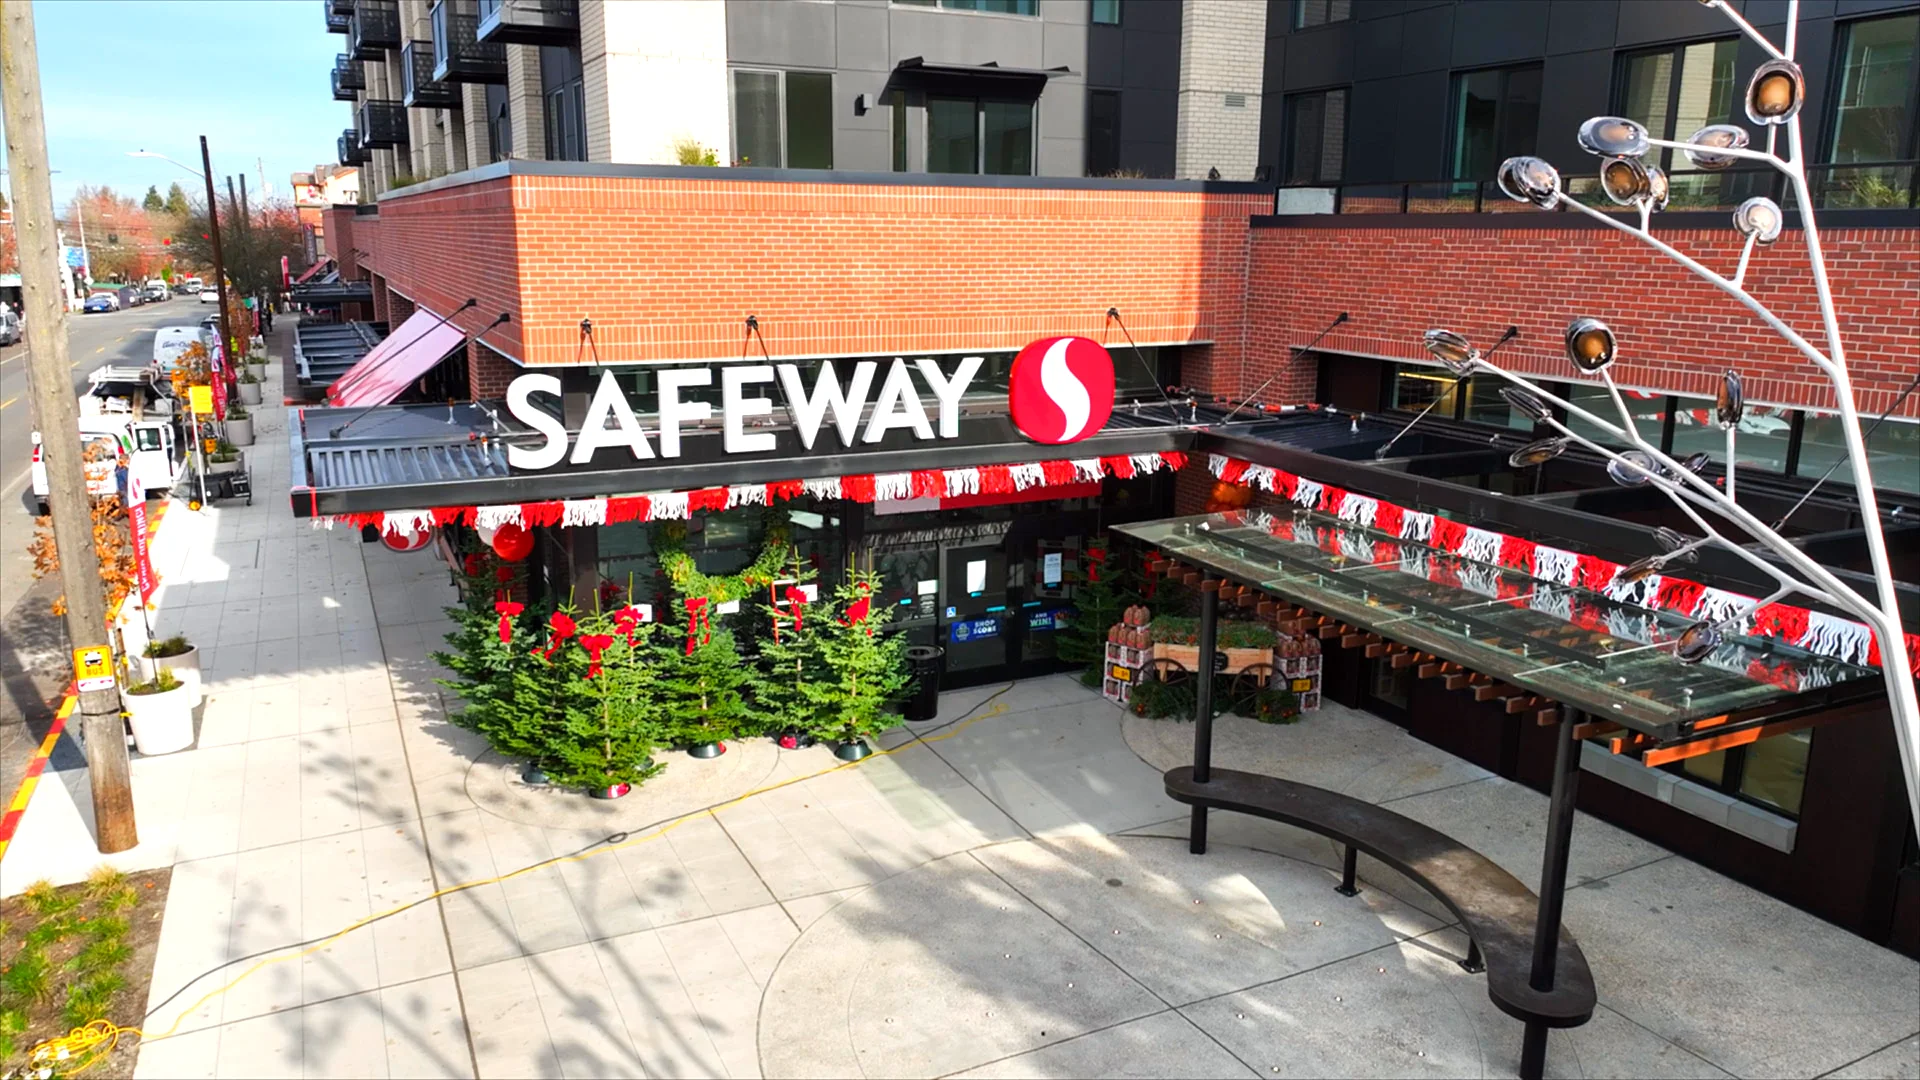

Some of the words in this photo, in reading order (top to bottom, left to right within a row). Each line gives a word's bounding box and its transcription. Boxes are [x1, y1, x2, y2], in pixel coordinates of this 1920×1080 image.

[506, 356, 985, 470] SAFEWAY
[974, 619, 996, 628] SHOP
[86, 667, 104, 676] BUS
